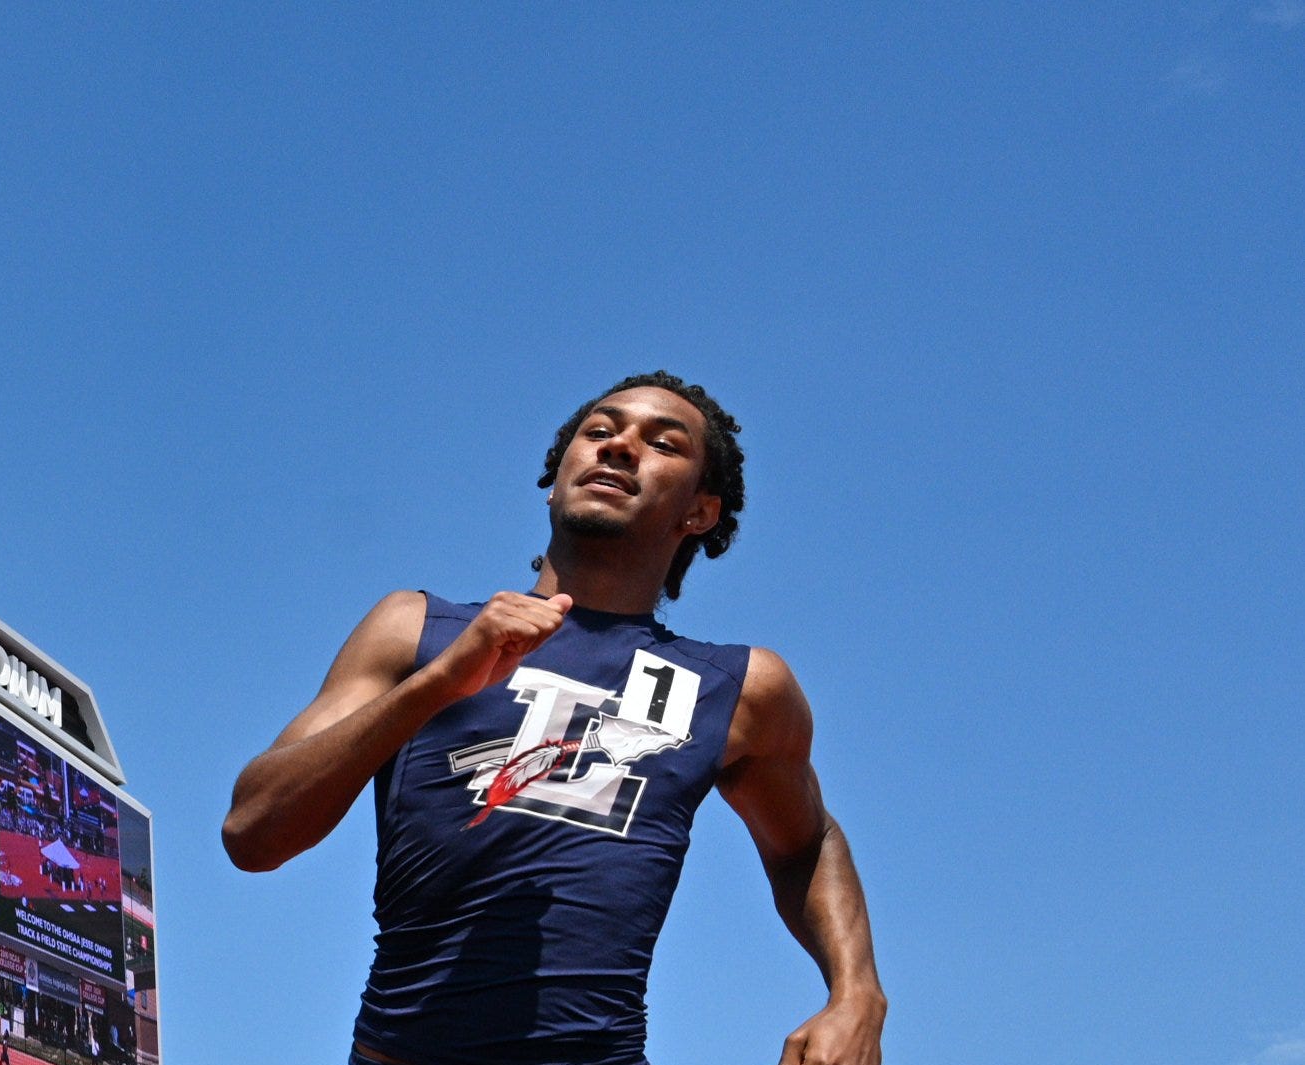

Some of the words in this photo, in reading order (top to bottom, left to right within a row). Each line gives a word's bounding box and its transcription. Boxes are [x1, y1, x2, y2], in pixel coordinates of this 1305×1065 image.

[643, 664, 674, 723] 1
[15, 907, 44, 929] WELCOME
[42, 920, 52, 932] TO
[51, 923, 62, 937] THE
[62, 929, 81, 945] OHSAA
[81, 937, 94, 951] JESSE
[95, 943, 113, 959] OWENS
[17, 922, 35, 940] TRACK
[41, 933, 56, 948] FIELD
[56, 940, 72, 956] STATE
[72, 947, 113, 973] CHAMPIONSHIPS
